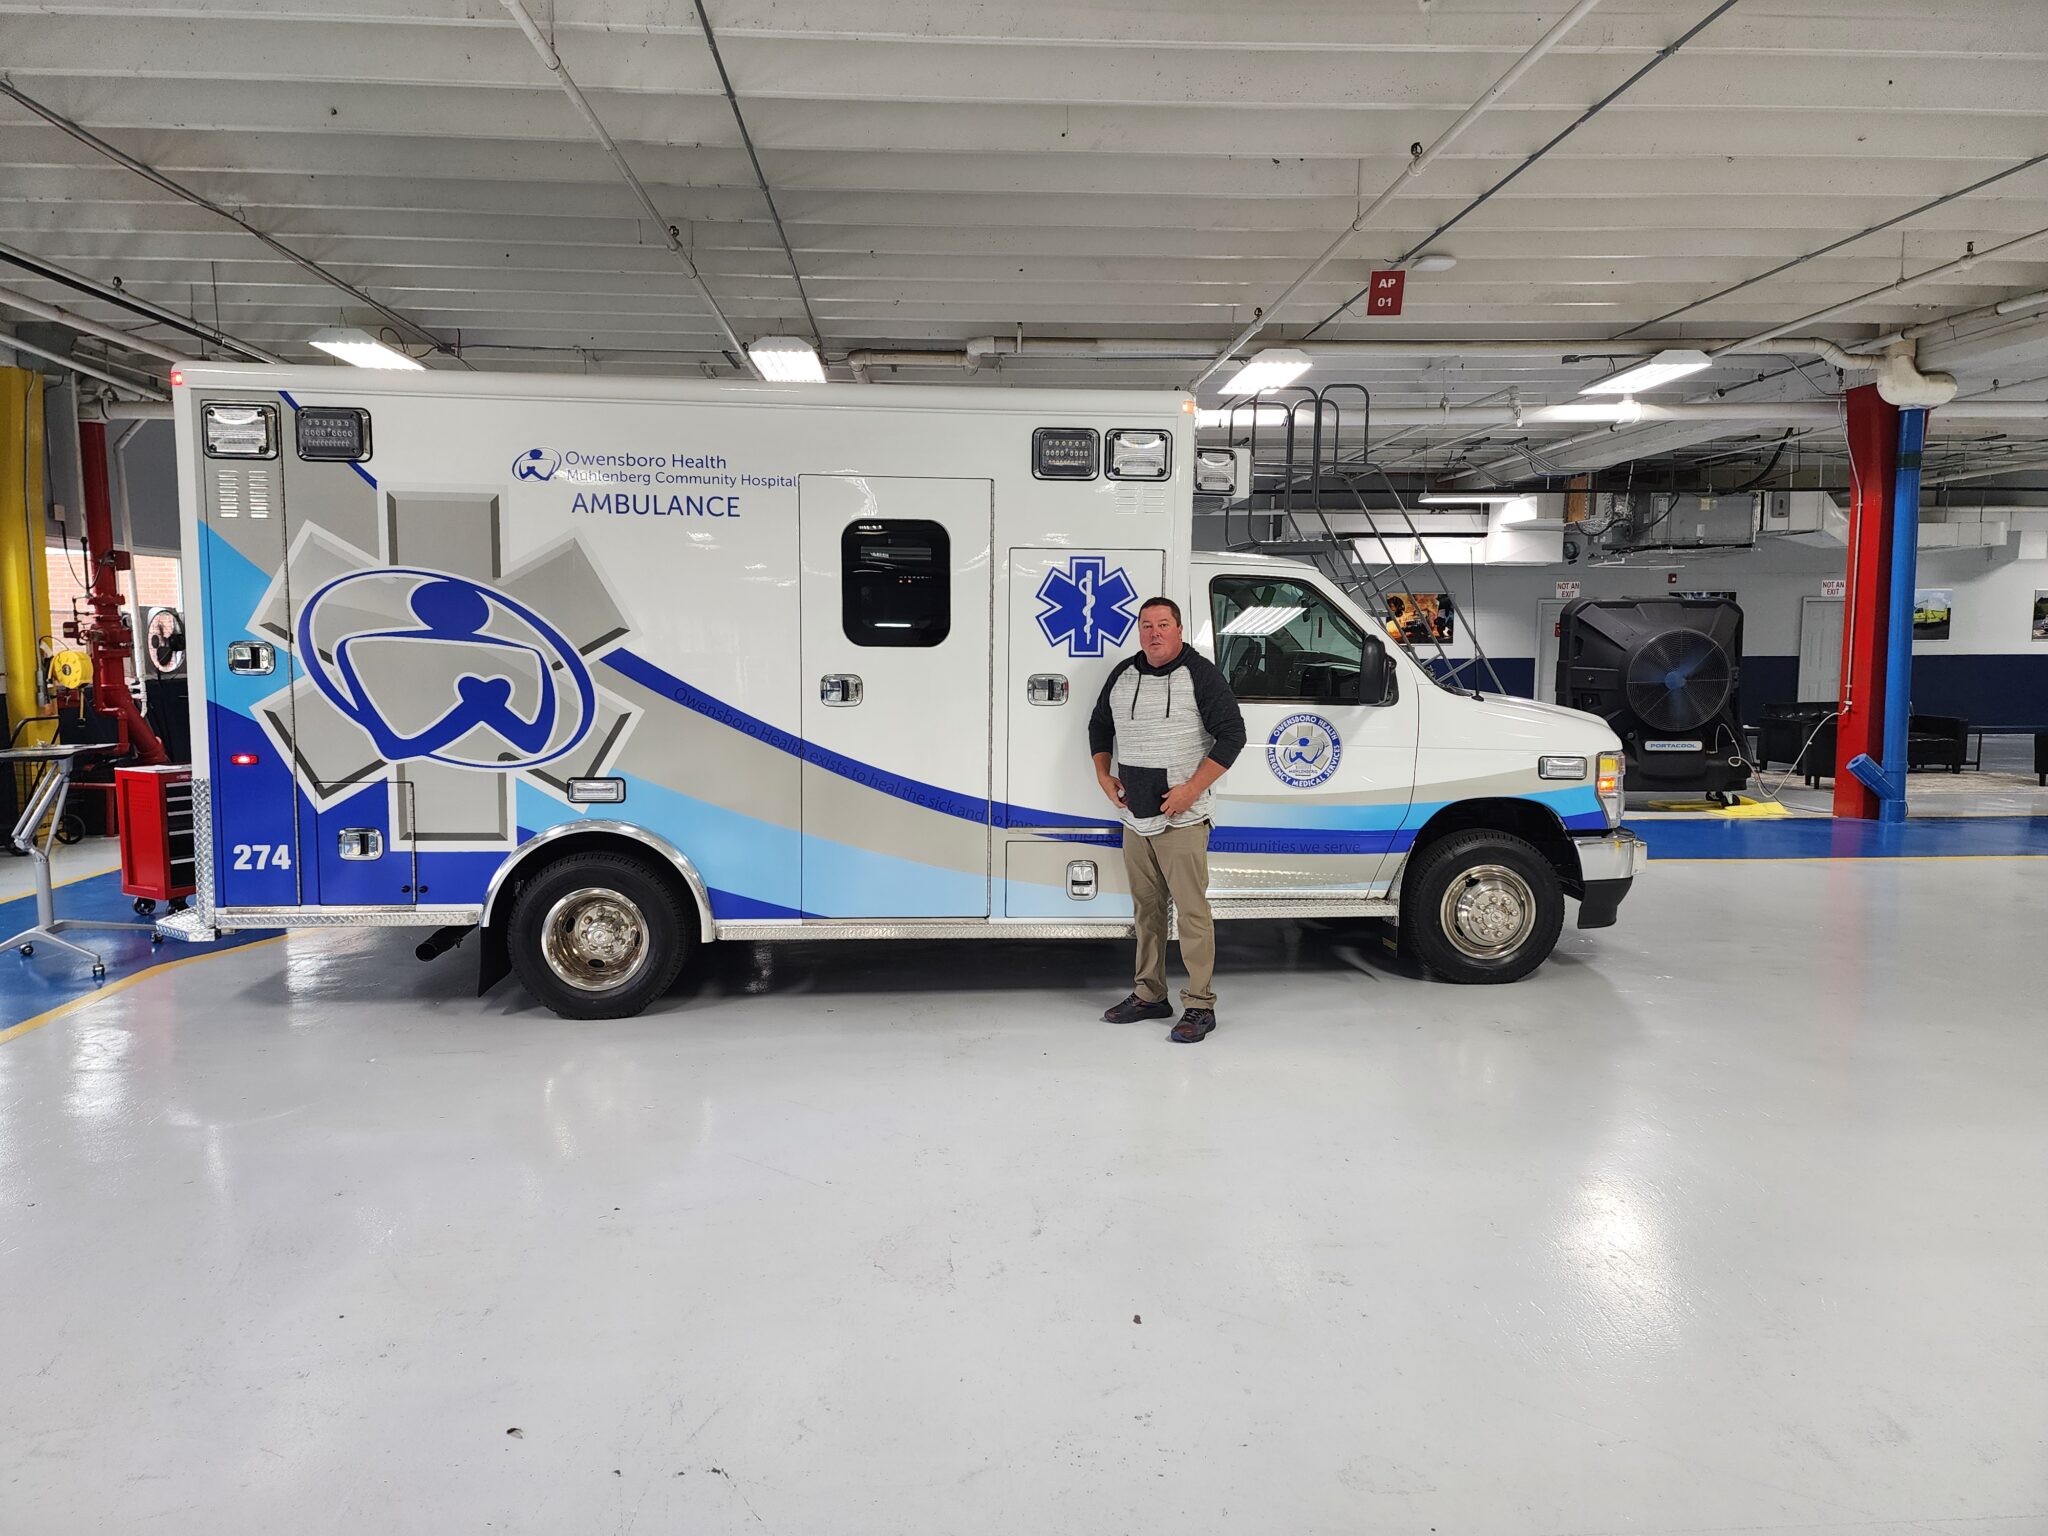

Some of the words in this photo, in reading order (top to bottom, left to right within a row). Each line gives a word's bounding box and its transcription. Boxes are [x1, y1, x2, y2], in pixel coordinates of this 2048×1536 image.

[1378, 278, 1397, 289] AP
[1377, 297, 1392, 307] 01
[565, 450, 666, 468] Owensboro
[672, 453, 727, 470] Health
[567, 469, 651, 486] Muhlenberg
[655, 471, 737, 488] Community
[741, 473, 797, 488] Hospital
[571, 493, 741, 517] AMBULANCE
[1826, 588, 1840, 596] EXIT
[1273, 715, 1317, 737] OWENSBORO
[1317, 719, 1338, 741] HEALTH
[674, 687, 758, 736] Owensboro
[760, 726, 807, 757] Health
[809, 750, 849, 776] exists
[853, 766, 867, 782] to
[869, 773, 901, 796] heal
[902, 785, 927, 804] the
[928, 794, 954, 814] sick
[954, 804, 986, 823] and
[1299, 843, 1316, 853] we
[1323, 842, 1361, 853] serve
[1268, 745, 1291, 783] MERGENCY
[1291, 775, 1325, 787] MEDICAL
[1326, 744, 1341, 777] SERVICES
[233, 844, 291, 870] 274
